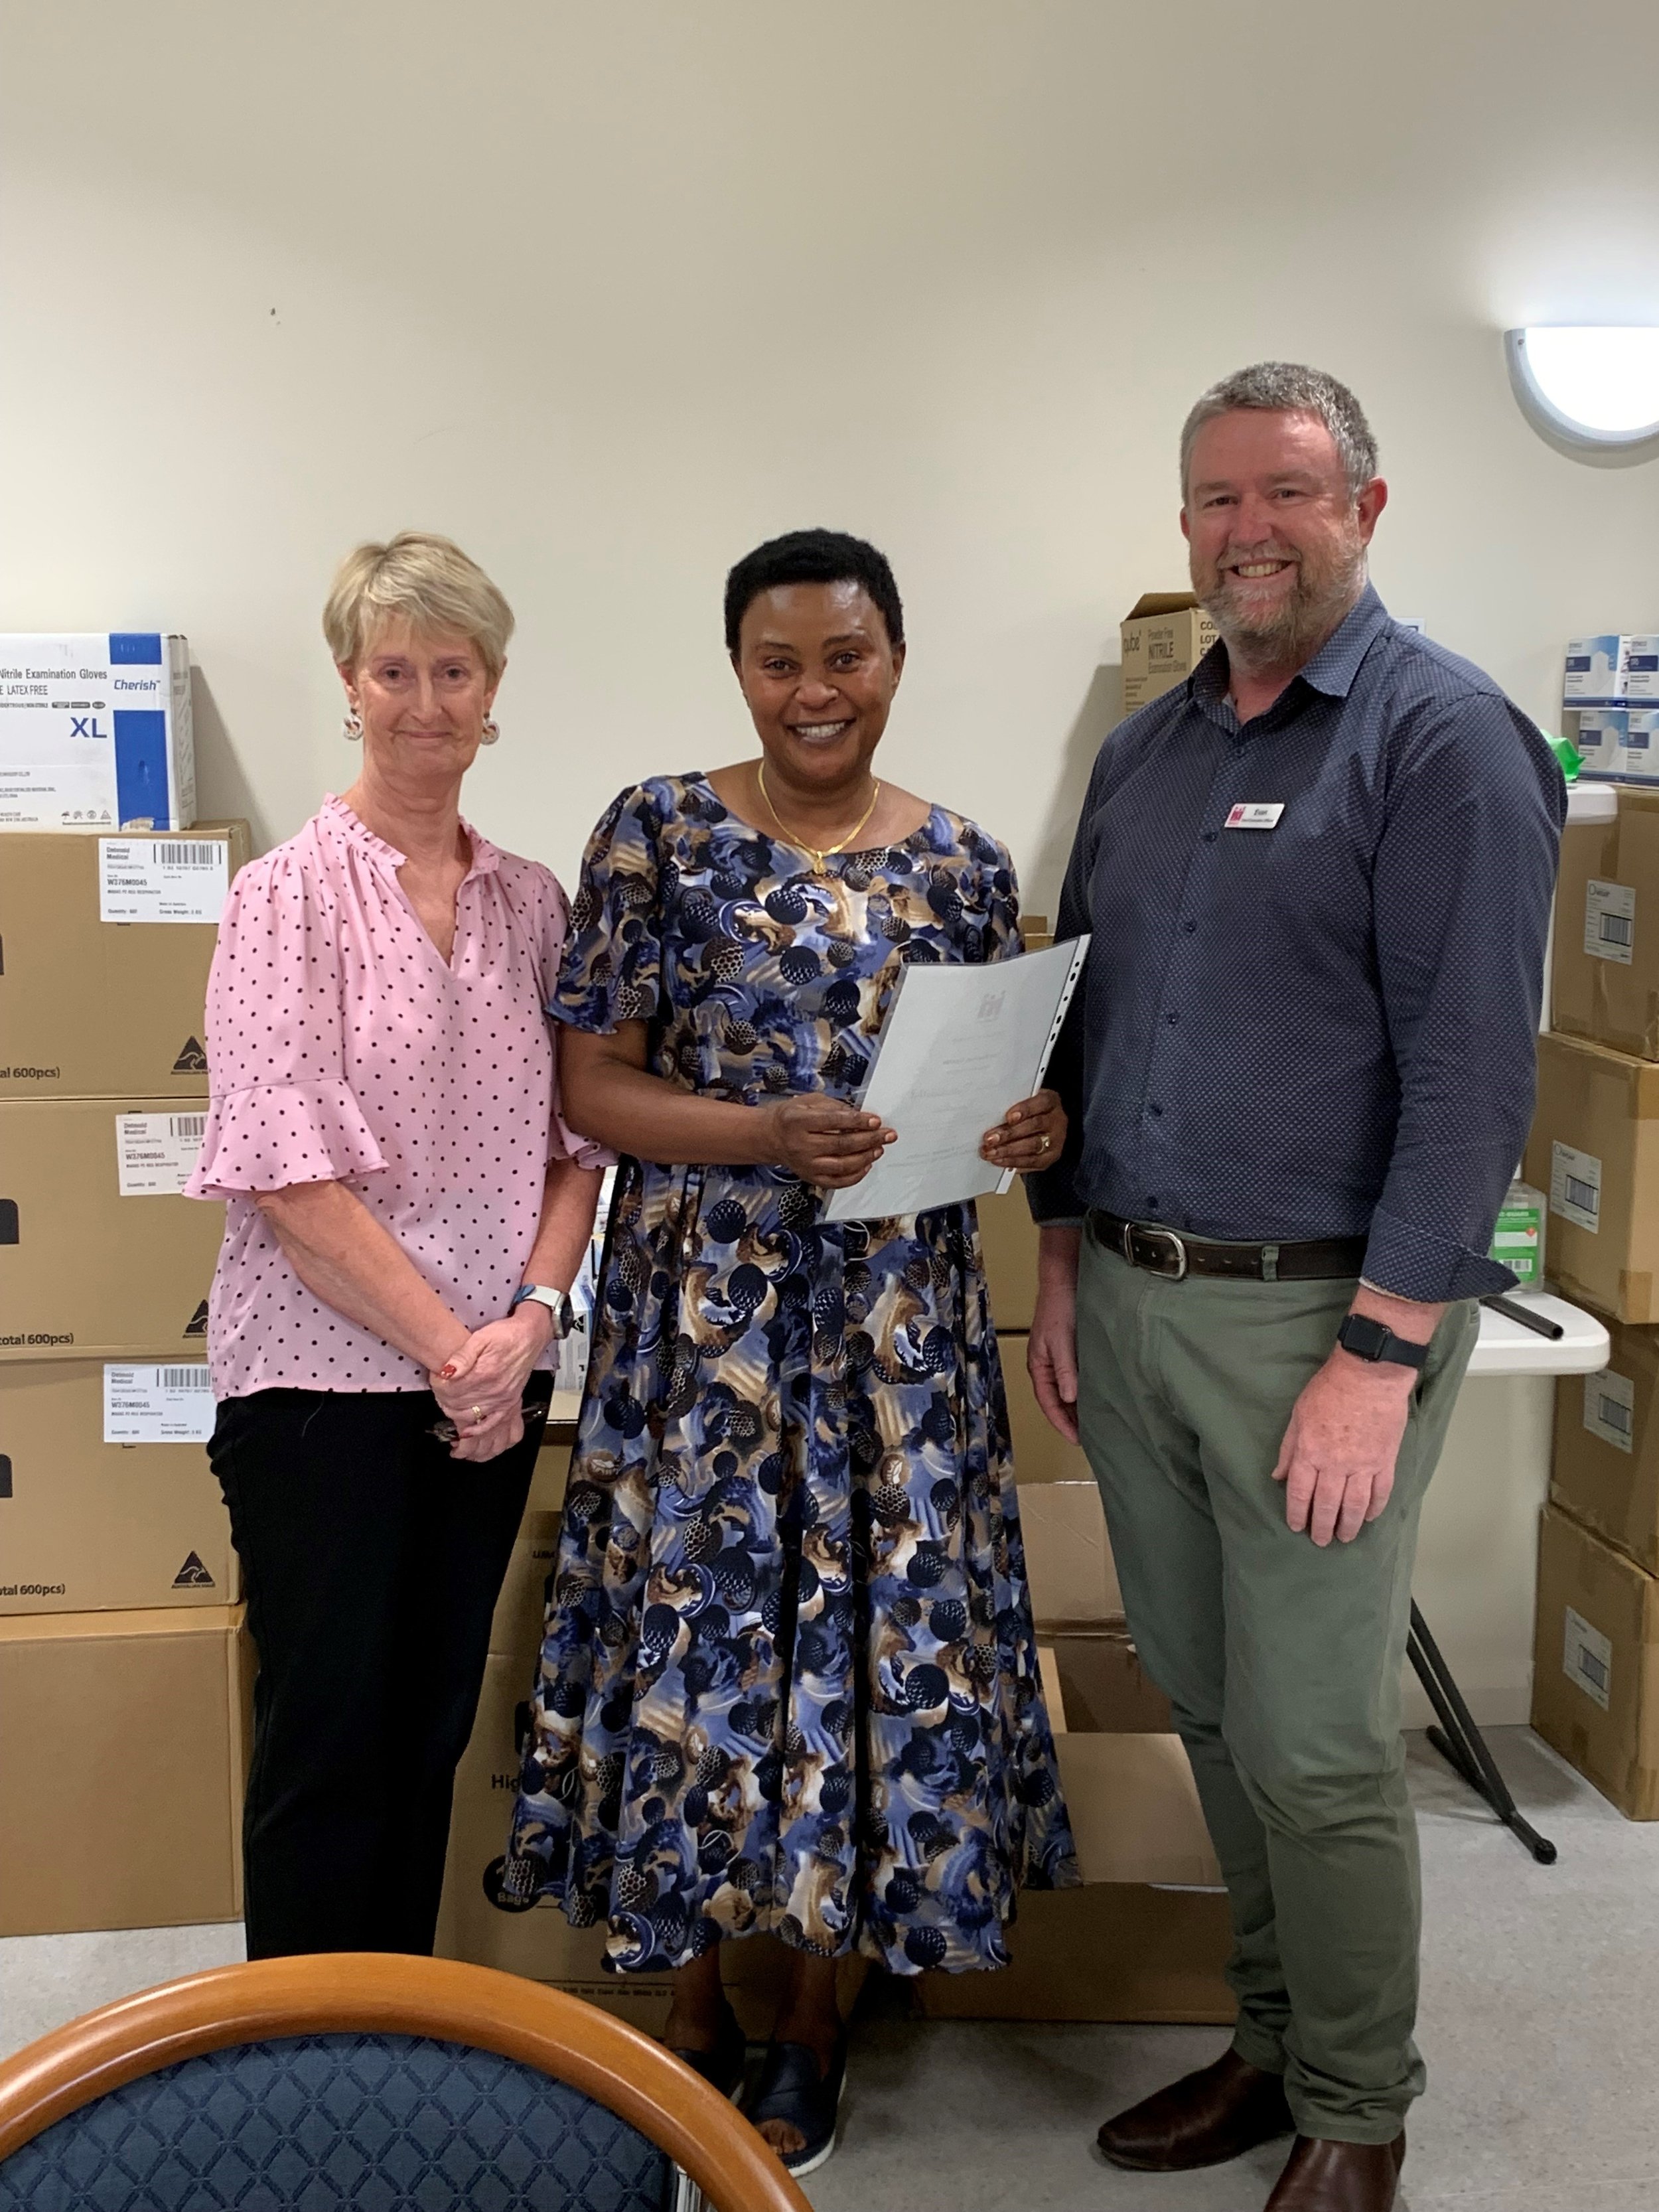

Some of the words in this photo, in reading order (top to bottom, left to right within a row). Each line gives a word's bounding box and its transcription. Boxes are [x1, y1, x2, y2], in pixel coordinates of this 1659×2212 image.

[1149, 641, 1174, 660] NITRILE
[0, 668, 23, 680] Nitrile
[26, 668, 76, 680] Examination
[80, 668, 108, 680] Gloves
[7, 685, 29, 696] LATEX
[30, 685, 48, 696] FREE
[70, 717, 108, 738] XL
[13, 1067, 60, 1080] 600pcs)
[27, 1333, 74, 1346] 600pcs)
[20, 1584, 66, 1596] 600pcs)
